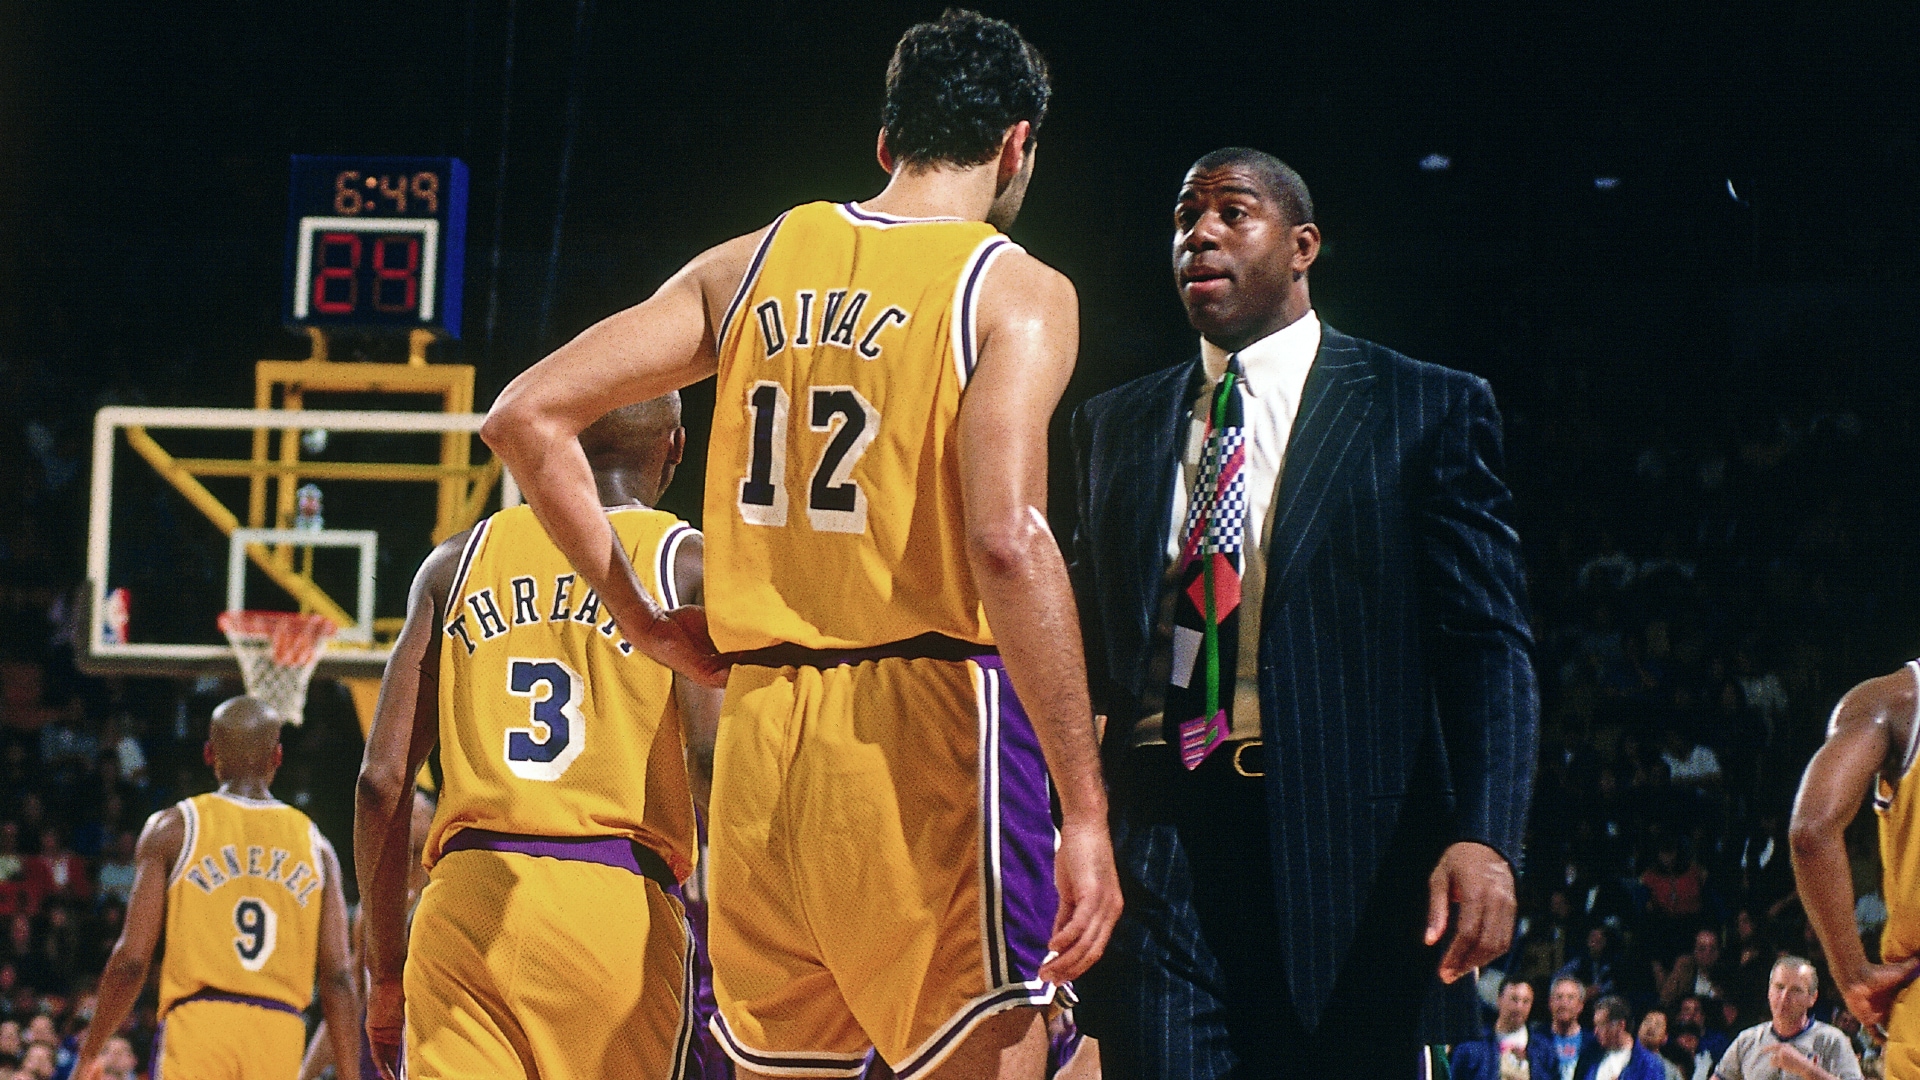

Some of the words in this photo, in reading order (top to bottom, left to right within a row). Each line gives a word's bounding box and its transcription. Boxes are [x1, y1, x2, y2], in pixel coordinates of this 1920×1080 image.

[335, 171, 439, 214] 6:49
[313, 233, 418, 313] 24
[754, 289, 910, 359] DIVAC
[738, 381, 878, 531] 12
[444, 572, 633, 655] THREA
[504, 657, 582, 777] 3
[233, 897, 274, 968] 9
